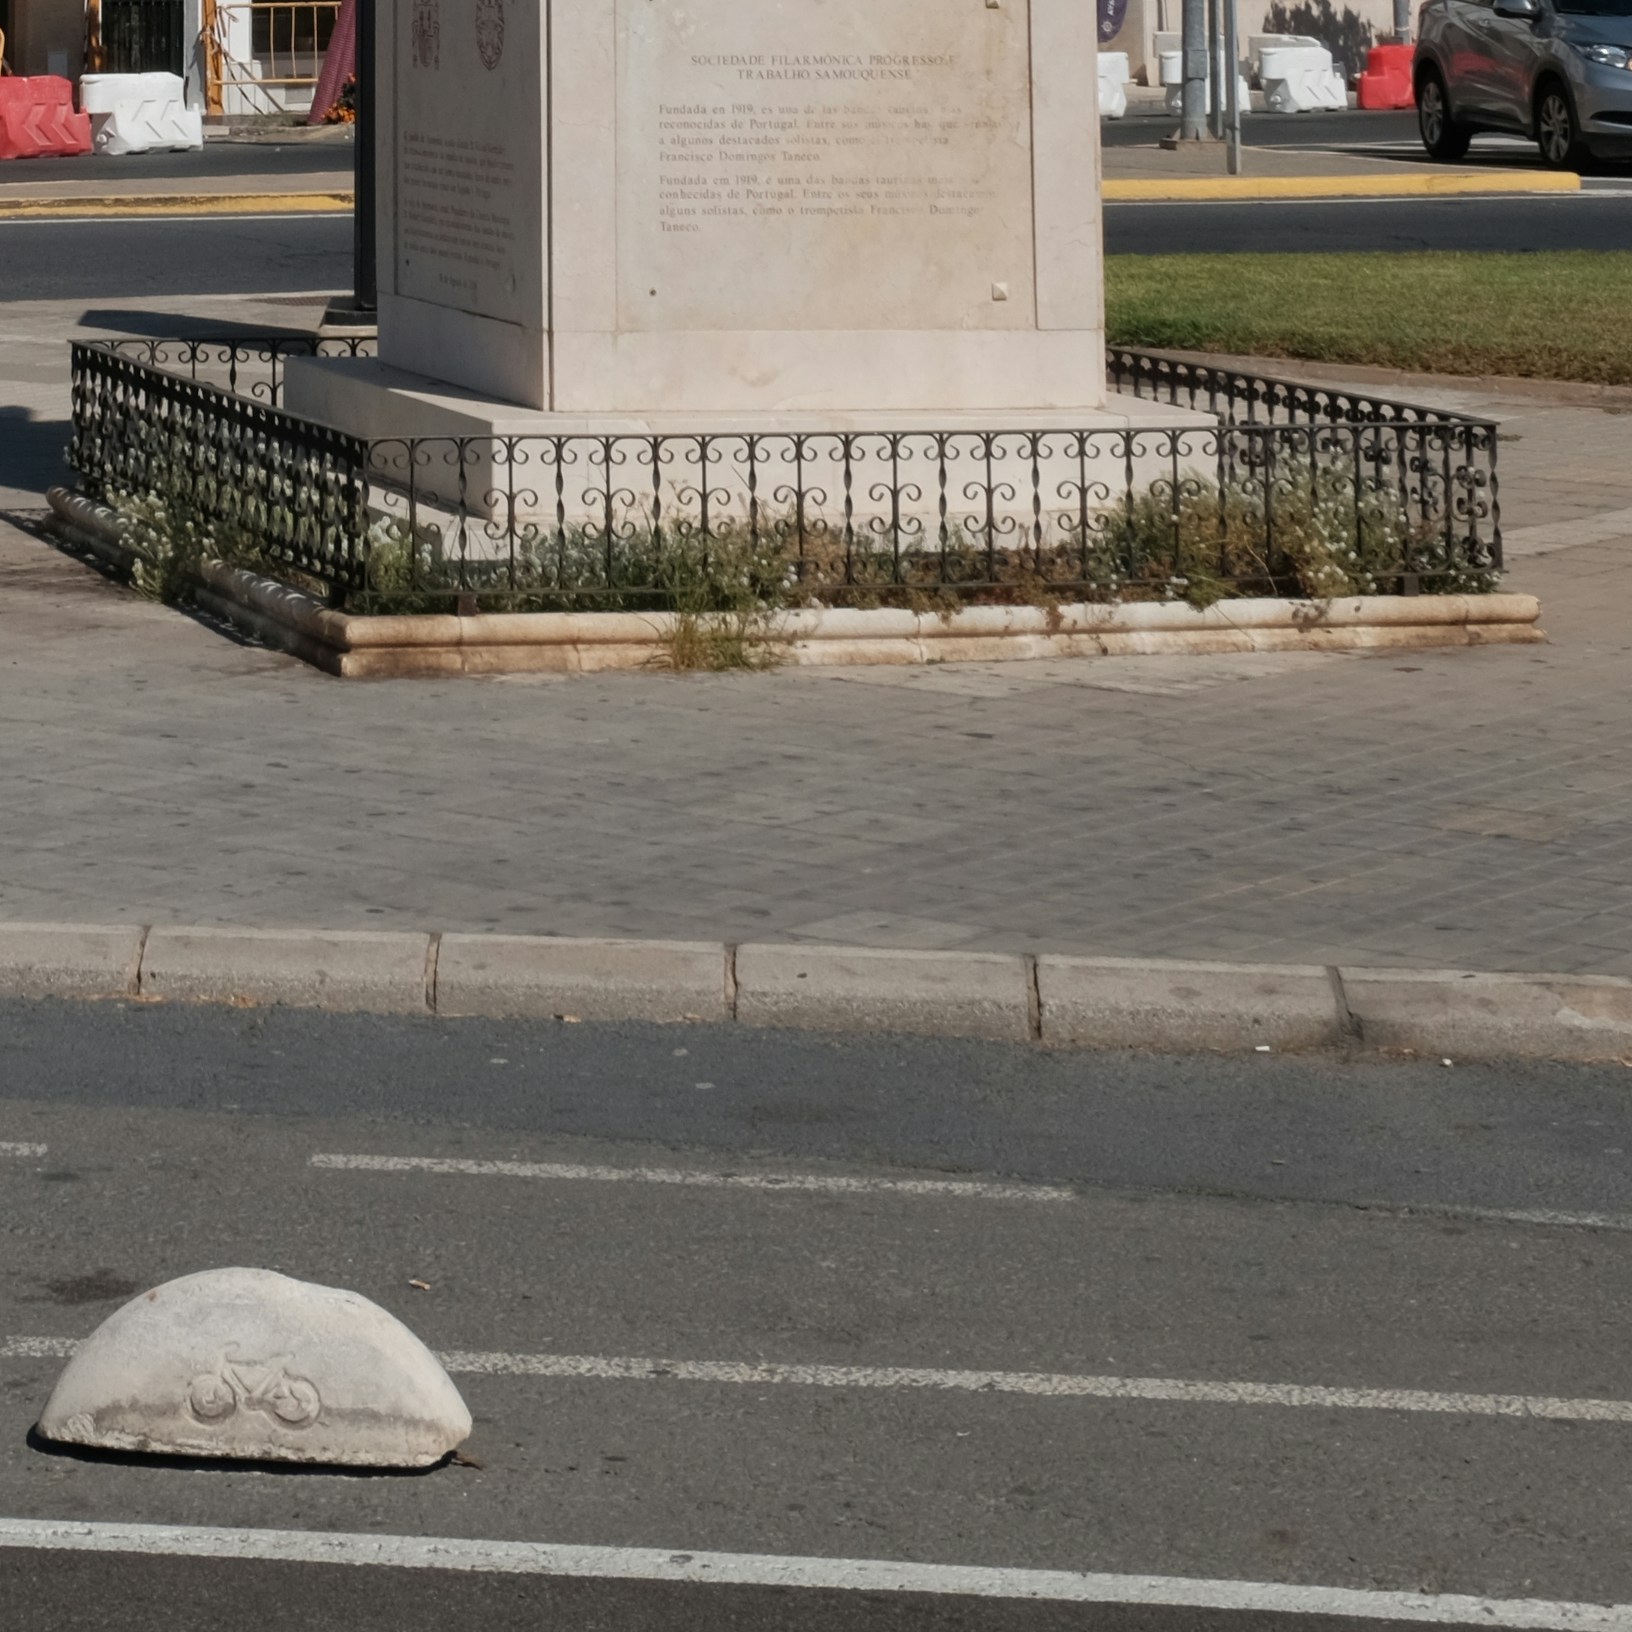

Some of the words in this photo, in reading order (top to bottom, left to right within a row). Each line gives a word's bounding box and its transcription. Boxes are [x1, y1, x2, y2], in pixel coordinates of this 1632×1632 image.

[690, 55, 765, 67] SOCIEDADE
[869, 55, 944, 67] PROGRESSO
[738, 69, 810, 81] TRABALHO
[815, 69, 912, 82] SAMOUQUENSE
[659, 104, 707, 115] Fundada
[712, 106, 725, 115] en
[731, 104, 756, 116] 1919,
[761, 106, 773, 115] es
[779, 106, 799, 115] una
[659, 119, 726, 130] reconocidas
[731, 119, 744, 130] de
[670, 135, 713, 147] algunos
[719, 135, 780, 145] destacados
[659, 151, 713, 162] Francisco
[719, 151, 776, 164] Domingos
[659, 175, 707, 186] Fundada
[713, 178, 730, 186] em
[777, 178, 800, 186] uma
[806, 176, 825, 186] das
[659, 189, 722, 200] conhecidas
[727, 189, 740, 200] de
[838, 192, 850, 200] os
[855, 192, 879, 200] seus
[659, 206, 697, 218] alguns
[752, 208, 783, 217] como
[788, 209, 794, 217] o
